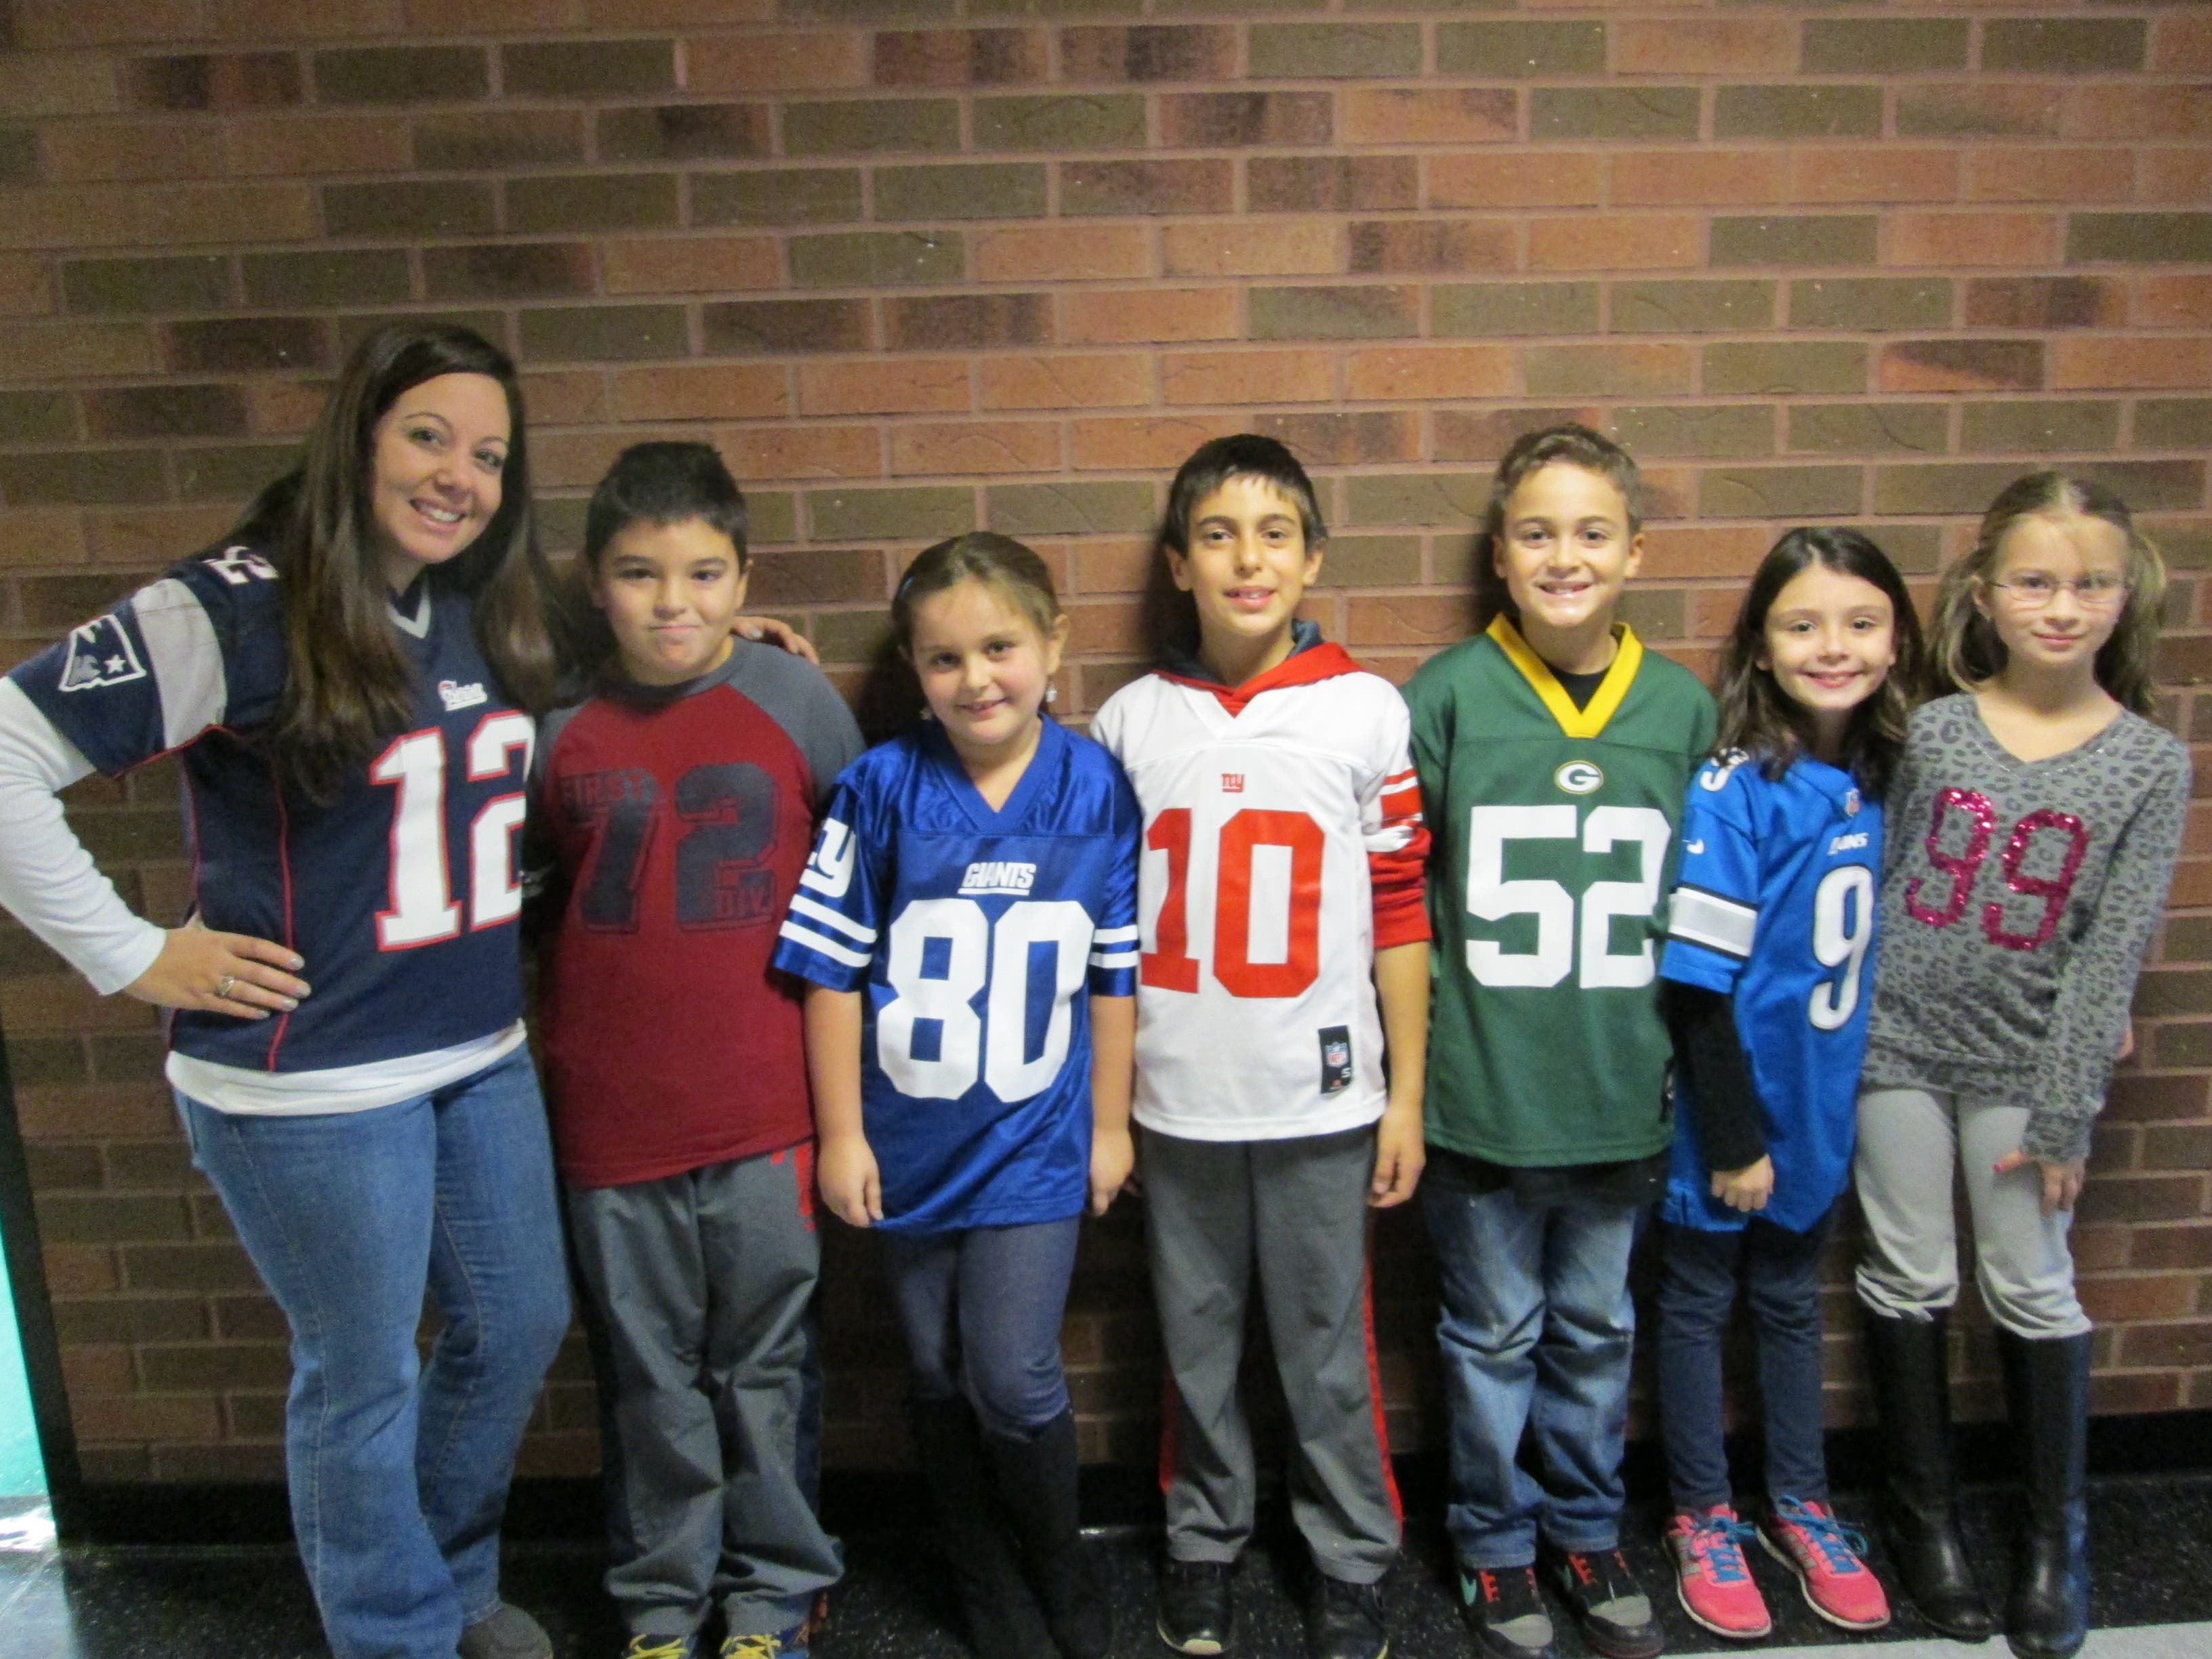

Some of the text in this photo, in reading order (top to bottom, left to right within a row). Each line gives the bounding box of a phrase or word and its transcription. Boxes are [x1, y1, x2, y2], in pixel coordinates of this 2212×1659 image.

[369, 710, 535, 951] 12
[558, 762, 778, 933] 72
[962, 861, 1037, 889] GIANTS
[1141, 808, 1325, 998] 10
[1465, 804, 1672, 989] 52
[1904, 787, 2089, 951] 99
[877, 899, 1096, 1103] 80
[1809, 865, 1875, 1031] 9
